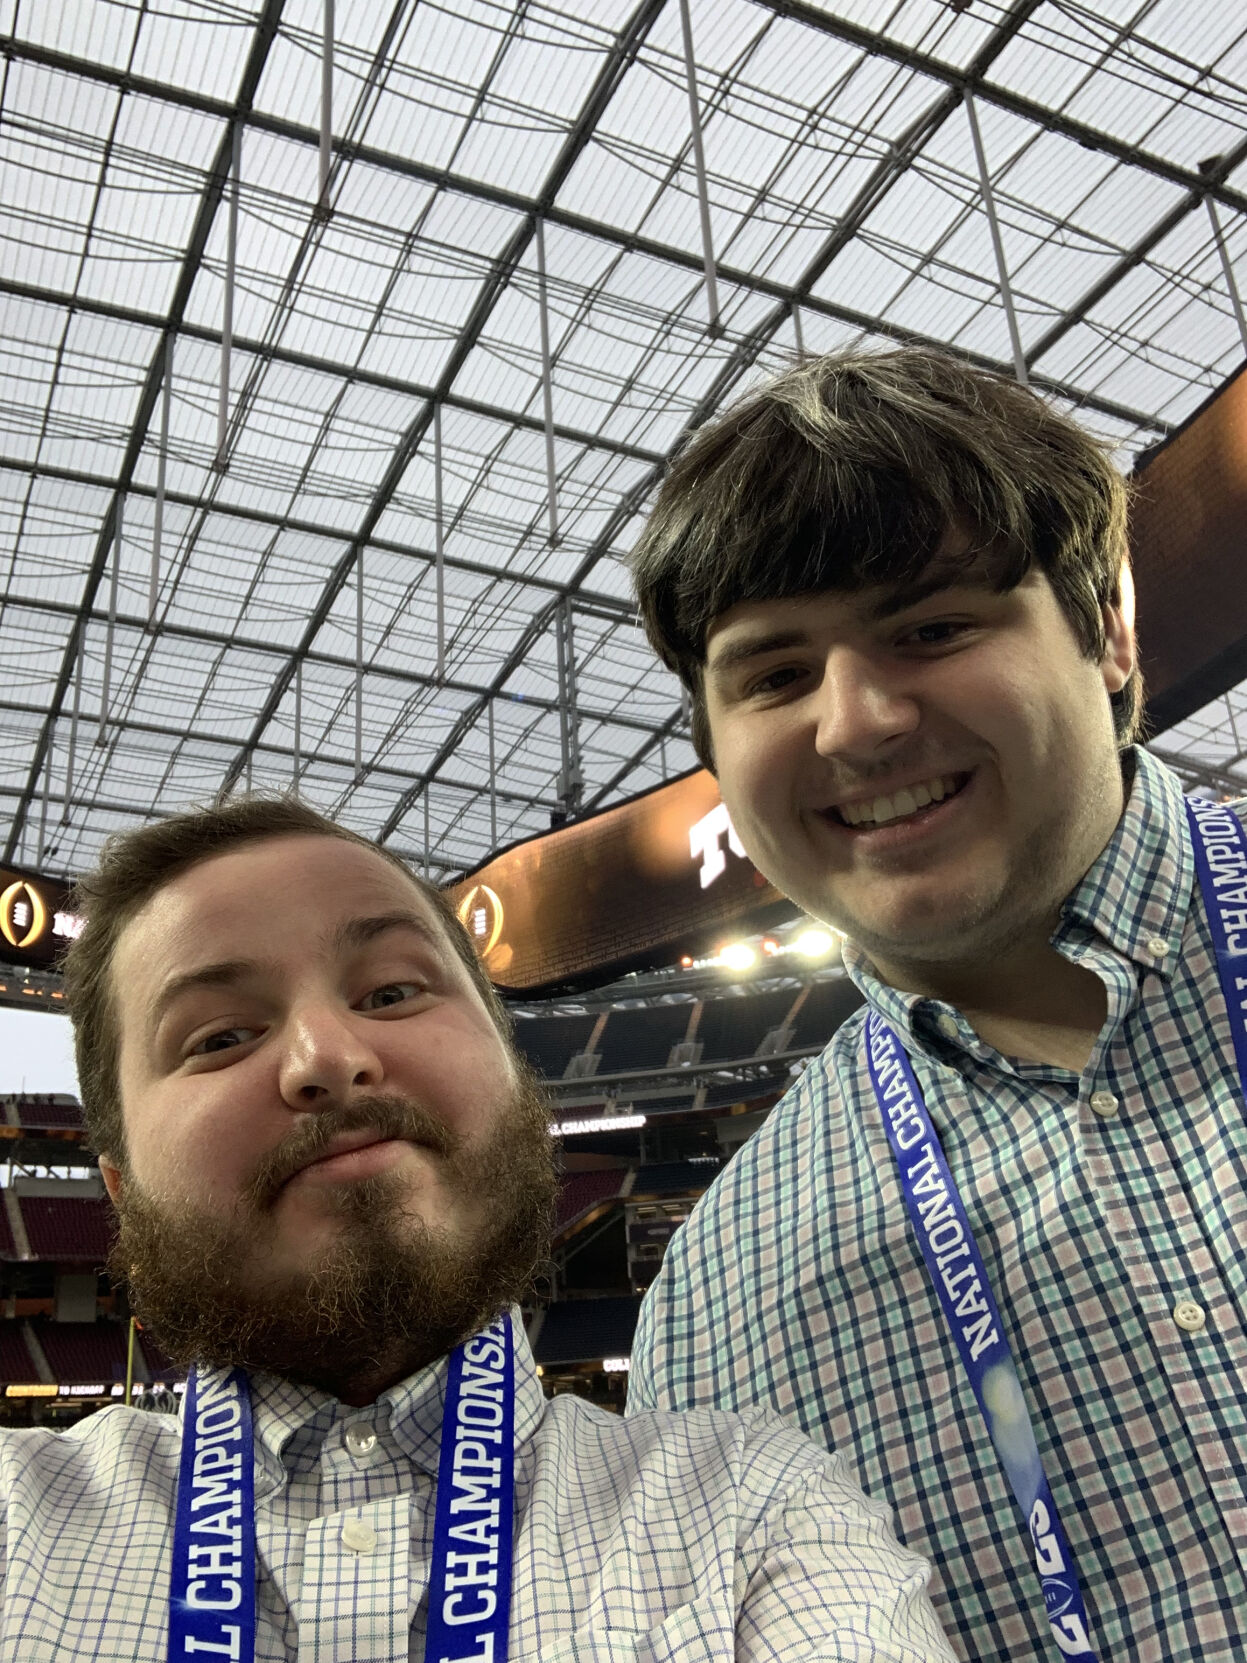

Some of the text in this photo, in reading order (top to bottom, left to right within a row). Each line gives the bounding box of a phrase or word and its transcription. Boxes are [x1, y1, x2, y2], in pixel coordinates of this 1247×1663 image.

[869, 1010, 999, 1362] NATIONAL CHAMPIO
[186, 1364, 242, 1610] CHAMPION
